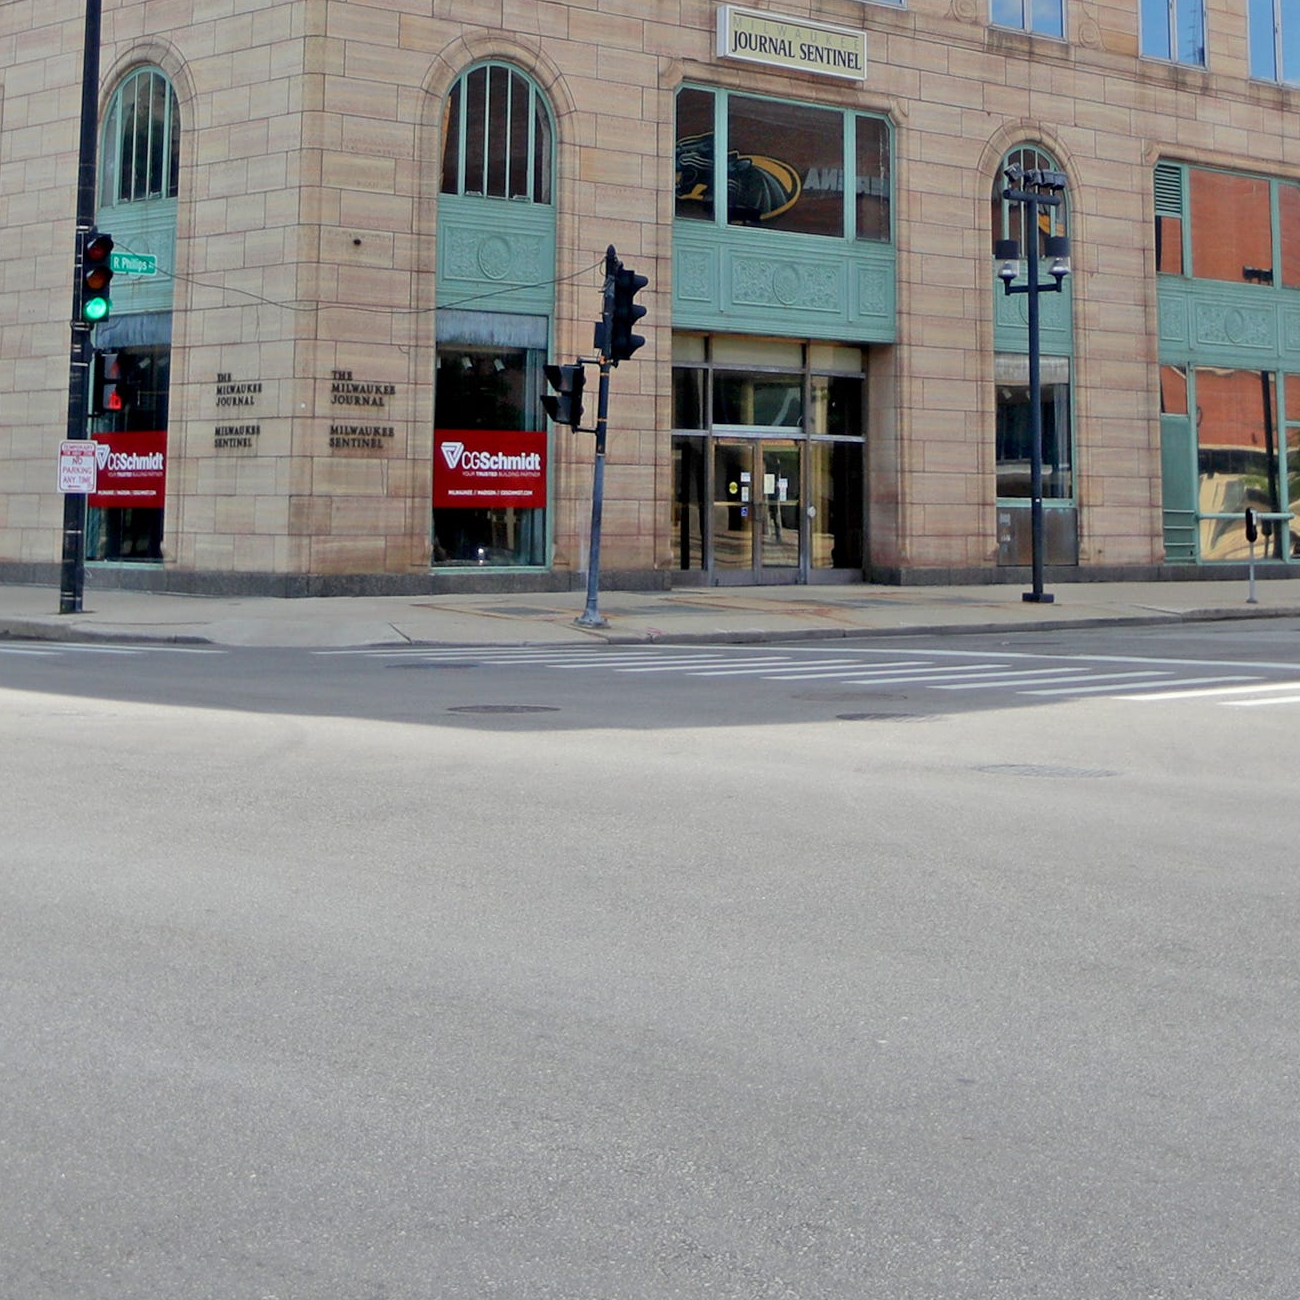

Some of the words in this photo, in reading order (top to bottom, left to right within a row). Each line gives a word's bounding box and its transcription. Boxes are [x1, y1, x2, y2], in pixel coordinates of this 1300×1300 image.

[732, 16, 860, 51] MILWAUKEE
[731, 31, 795, 58] JOURNAL
[799, 43, 862, 71] SENTINEL
[217, 373, 232, 382] THE
[331, 371, 353, 381] THE
[216, 383, 262, 396] MILWAUKEE
[331, 383, 396, 395] MILWAUKEE
[216, 396, 255, 407] JOURNAL
[331, 395, 385, 407] JOURNAL
[215, 425, 261, 436] MILWAUKEE
[330, 425, 395, 437] MILWAUKEE
[214, 437, 253, 448] SENTINEL
[329, 437, 383, 449] SENTINEL
[107, 452, 164, 470] CGSchmidt
[461, 451, 541, 470] CGSchmidt
[63, 466, 93, 474] PARKING
